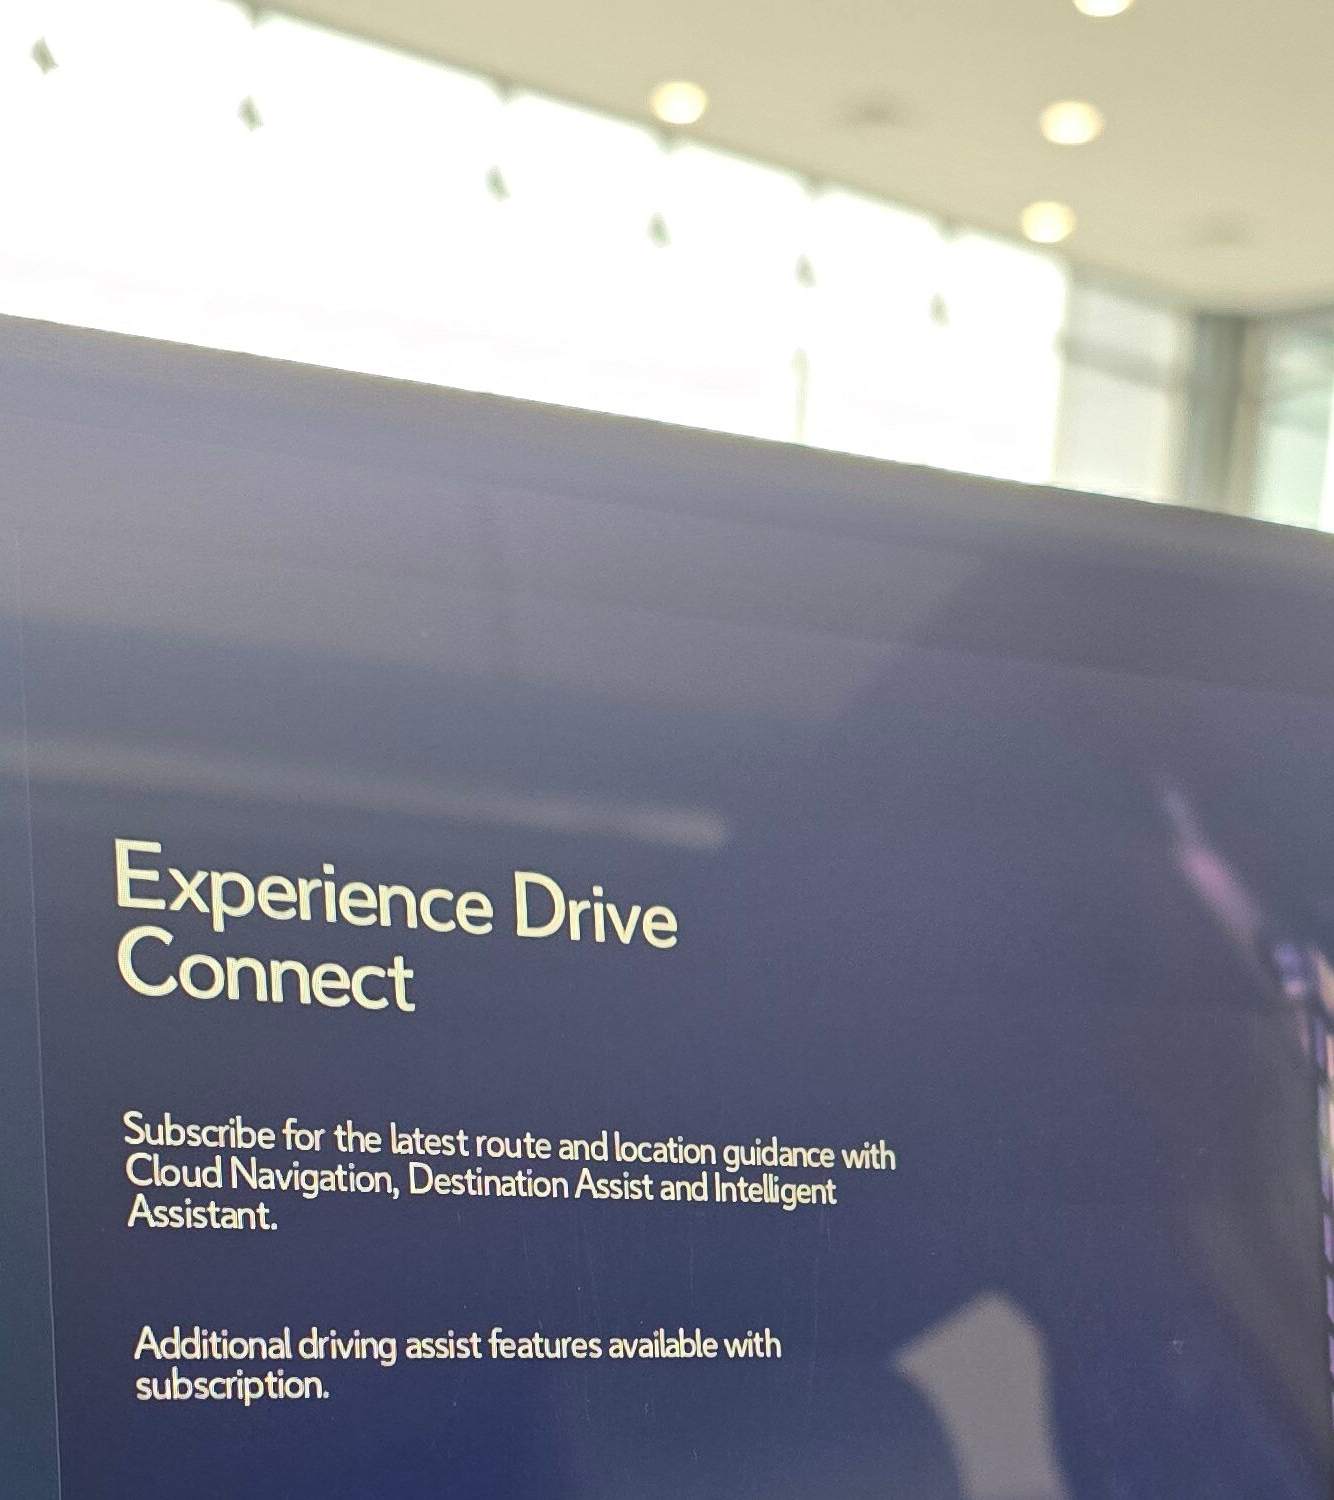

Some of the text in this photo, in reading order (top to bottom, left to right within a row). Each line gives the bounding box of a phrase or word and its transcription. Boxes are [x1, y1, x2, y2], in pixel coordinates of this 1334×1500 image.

[114, 837, 680, 949] Experience Drive
[116, 924, 417, 1013] Connect
[122, 1109, 897, 1174] Subscribe for the latest route and location guidance with
[125, 1151, 839, 1212] Cloud Navigation, Destination Assist and Intelligent
[126, 1192, 280, 1231] Assistant.
[133, 1324, 784, 1368] Additional driving assist features available with
[135, 1365, 331, 1408] subscription.
